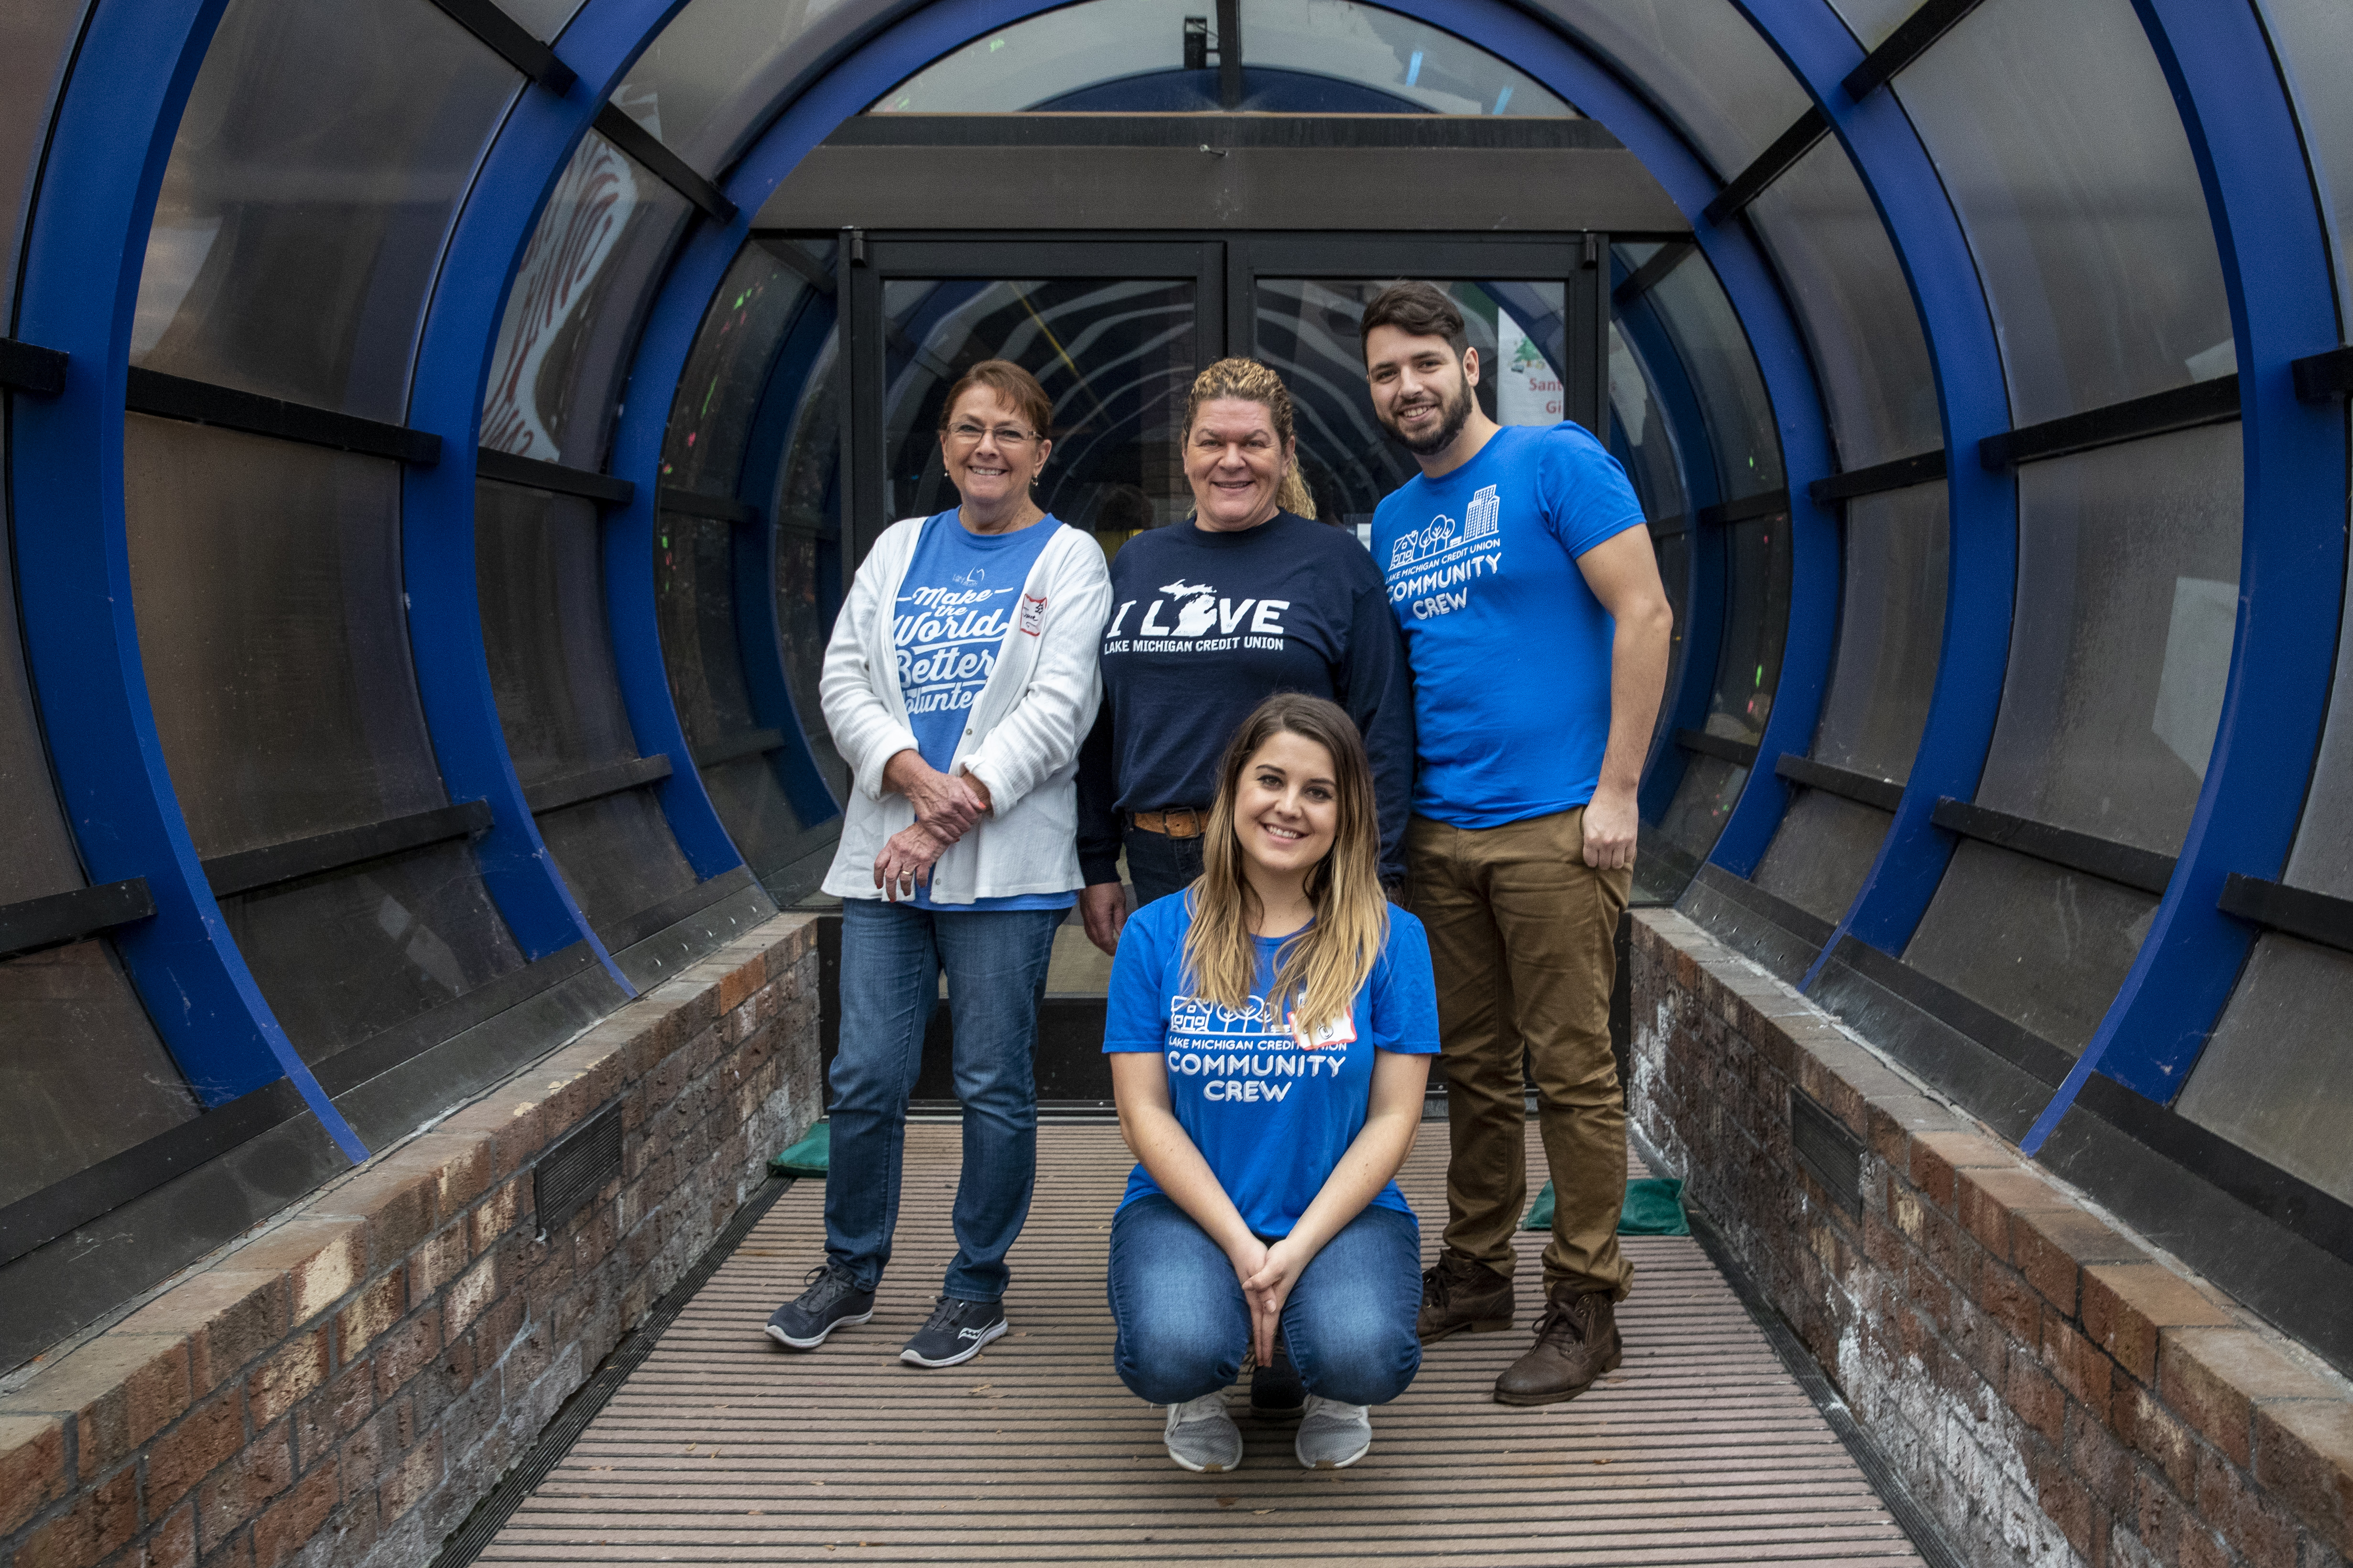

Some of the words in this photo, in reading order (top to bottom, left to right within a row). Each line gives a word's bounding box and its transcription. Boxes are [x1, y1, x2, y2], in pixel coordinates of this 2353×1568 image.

[1385, 571, 1401, 584] LAKE
[1401, 558, 1440, 577] MICHIGAN
[1442, 547, 1468, 564] CREDIT
[1470, 538, 1500, 554] UNION
[912, 587, 993, 609] Make
[934, 605, 968, 617] the
[1413, 587, 1467, 620] CREW
[893, 608, 1009, 647] World
[1106, 600, 1137, 638] I
[1104, 640, 1129, 655] LAKE
[1132, 639, 1193, 652] MICHIGAN
[1195, 637, 1241, 651] CREDIT
[1244, 636, 1284, 651] UNION
[896, 647, 995, 688] Better
[1169, 1035, 1190, 1049] LAKE
[1191, 1039, 1254, 1050] MICHIGAN
[1168, 1050, 1346, 1078] COMMUNITY
[1203, 1081, 1292, 1103] CREW
